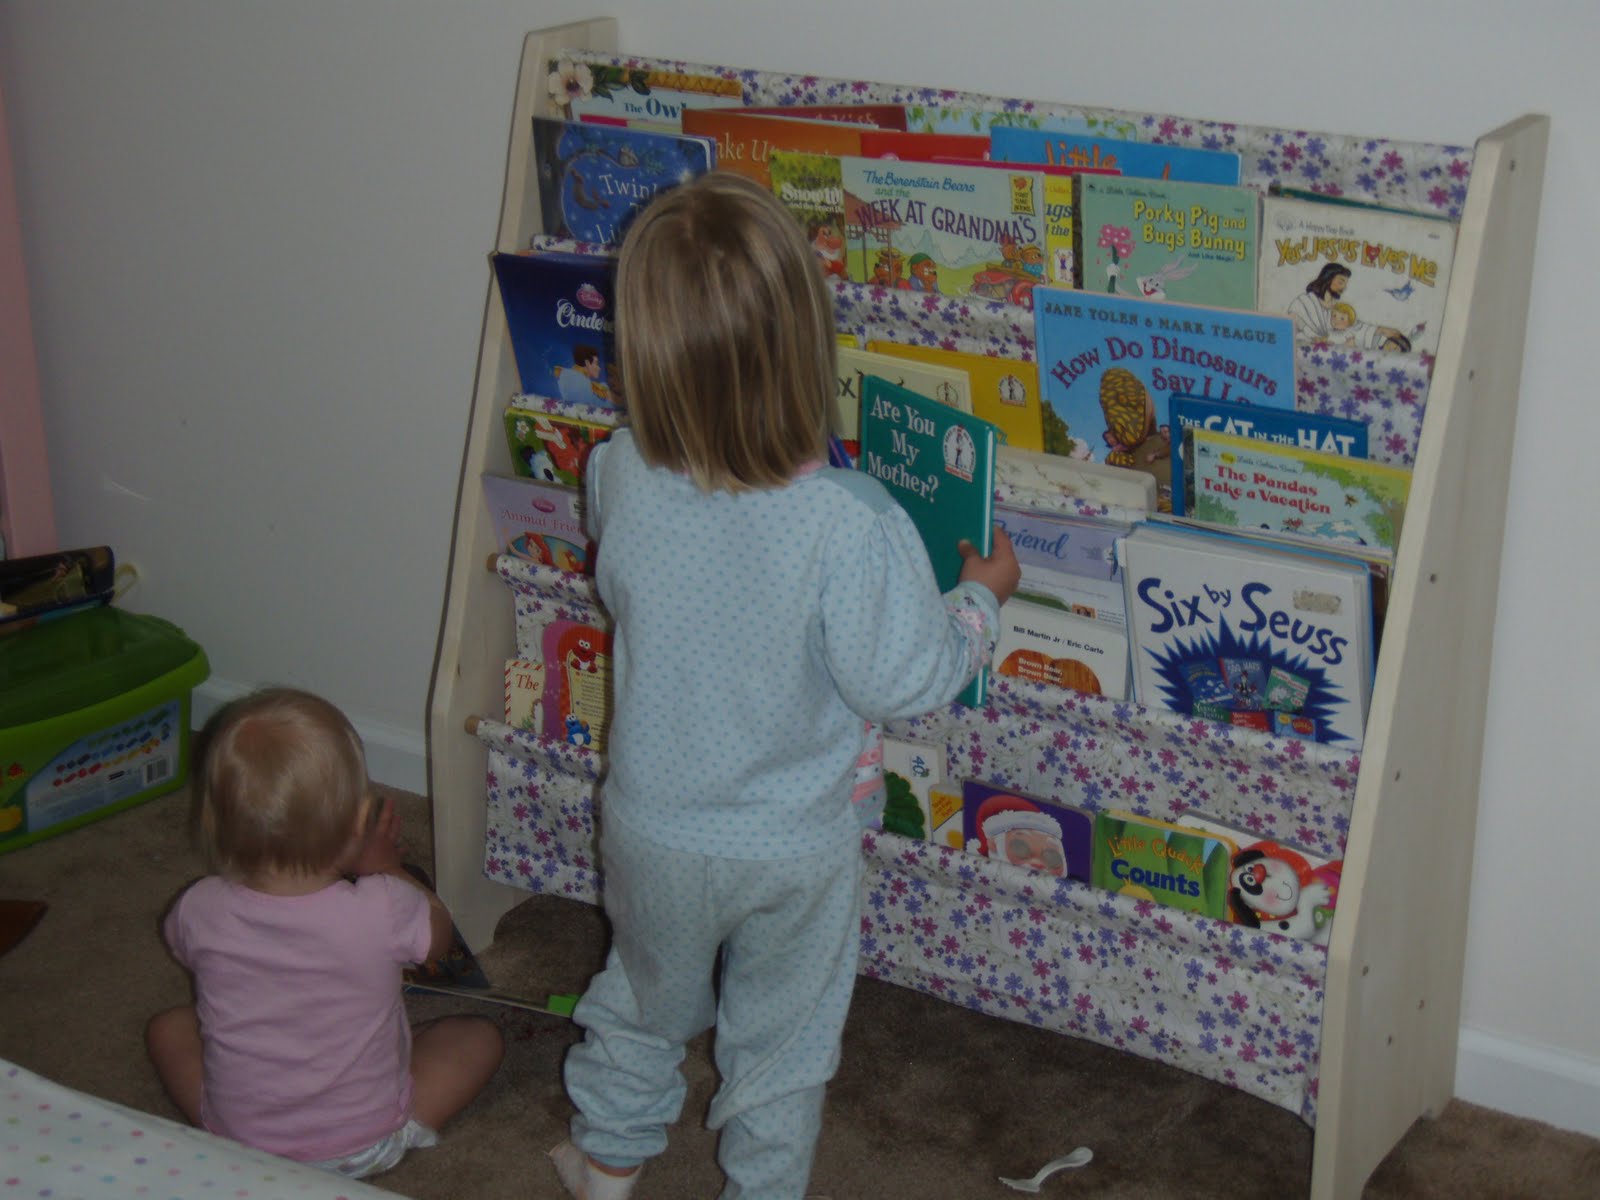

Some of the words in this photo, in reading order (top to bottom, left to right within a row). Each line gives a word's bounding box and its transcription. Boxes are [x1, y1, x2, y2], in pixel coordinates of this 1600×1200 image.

[624, 102, 643, 113] The
[646, 98, 687, 118] Ow
[863, 170, 884, 185] The
[884, 173, 940, 190] Berenstain
[942, 178, 976, 192] Bears
[875, 187, 893, 198] and
[894, 188, 911, 198] the
[855, 199, 903, 232] WEEK
[905, 200, 927, 227] AT
[931, 206, 1037, 245] GRANDMA'S
[1133, 199, 1186, 230] Porky
[1190, 204, 1219, 234] Pig
[1222, 217, 1247, 230] and
[1142, 223, 1186, 252] Bugs
[1190, 228, 1246, 261] Bunny
[1045, 302, 1082, 317] JANE
[1089, 308, 1138, 326] YOLEN
[1159, 317, 1205, 335] MARK
[1211, 325, 1277, 344] TEAGUE
[1051, 348, 1100, 389] How
[1105, 336, 1143, 361] Do
[1150, 335, 1278, 397] Dinosaurs
[1152, 368, 1195, 395] Say
[870, 393, 901, 423] Are
[903, 404, 936, 437] You
[891, 429, 920, 466] My
[1177, 415, 1201, 428] THE
[1203, 415, 1254, 437] CAT
[1253, 431, 1267, 441] IN
[1271, 434, 1295, 446] THE
[1297, 428, 1355, 458] HAT
[867, 451, 939, 503] Mother?
[1215, 465, 1247, 482] The
[1253, 473, 1318, 496] Pandas
[1202, 478, 1242, 500] Take
[1246, 489, 1256, 499] a
[1258, 489, 1331, 514] Vacation
[1000, 520, 1070, 560] riend
[1137, 577, 1214, 633] Six
[1203, 583, 1232, 608] by
[1239, 582, 1349, 665] Seuss
[1013, 626, 1025, 634] Bill
[1027, 629, 1051, 641] Martin
[1067, 640, 1082, 649] Eric
[1084, 644, 1104, 655] Carle
[1018, 657, 1042, 669] Brown
[1018, 666, 1042, 678] Brown
[516, 673, 539, 691] The
[1107, 835, 1147, 858] Little
[1152, 838, 1207, 875] Quack
[1111, 859, 1201, 897] Counts
